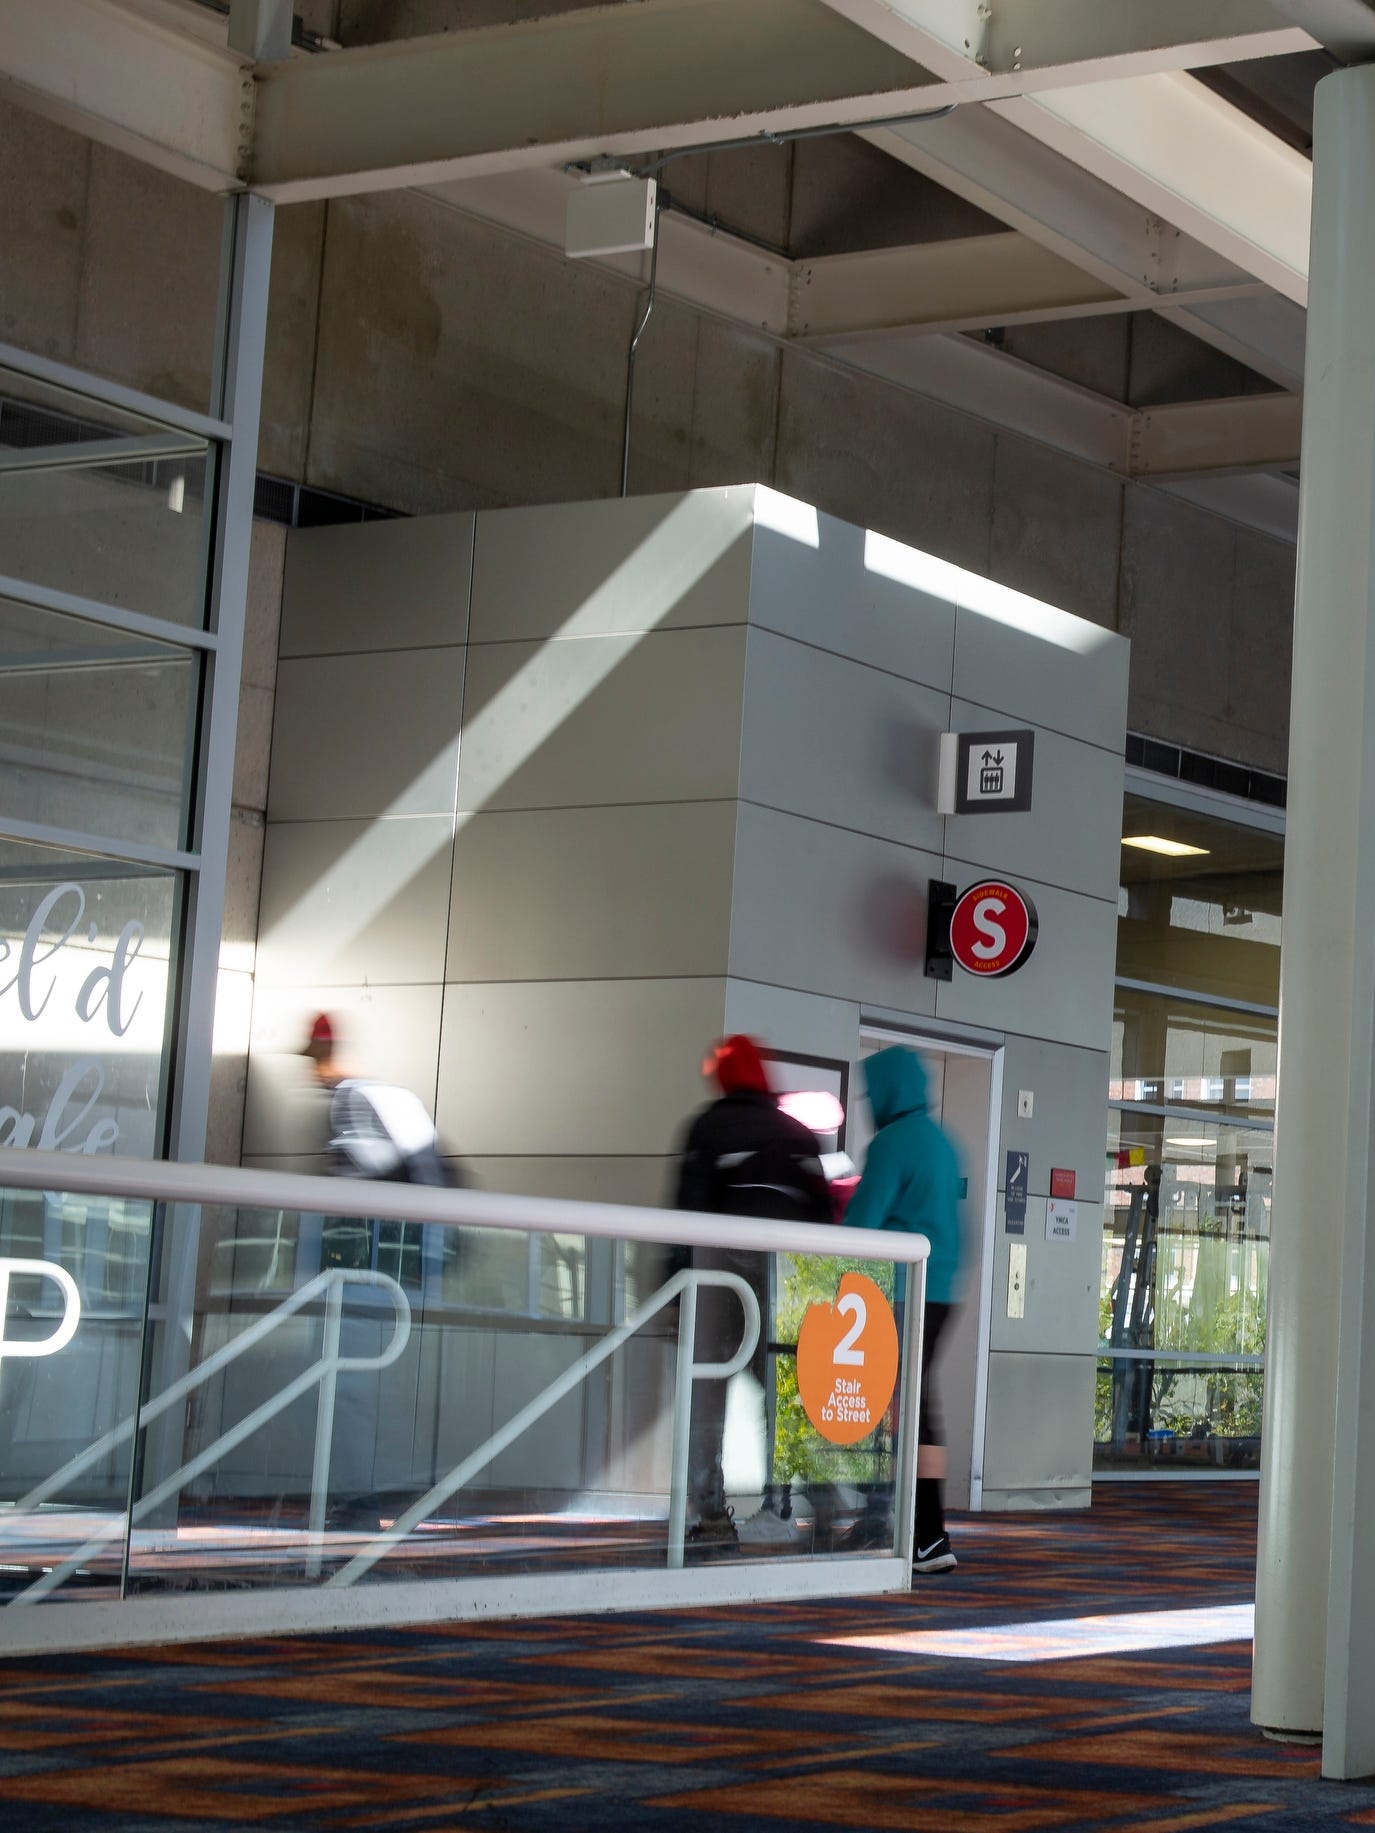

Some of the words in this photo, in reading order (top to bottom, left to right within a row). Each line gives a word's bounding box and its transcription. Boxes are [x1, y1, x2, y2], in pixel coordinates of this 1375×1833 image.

[972, 888, 1009, 901] SIDEWALK
[971, 897, 1006, 960] S
[974, 960, 1001, 970] ACCESS
[1055, 1216, 1069, 1225] YMCA
[1053, 1227, 1070, 1236] ACCESS
[832, 1292, 867, 1366] 2
[835, 1377, 861, 1394] Stair
[828, 1392, 866, 1408] Access
[821, 1406, 834, 1421] to
[837, 1407, 871, 1424] Street
